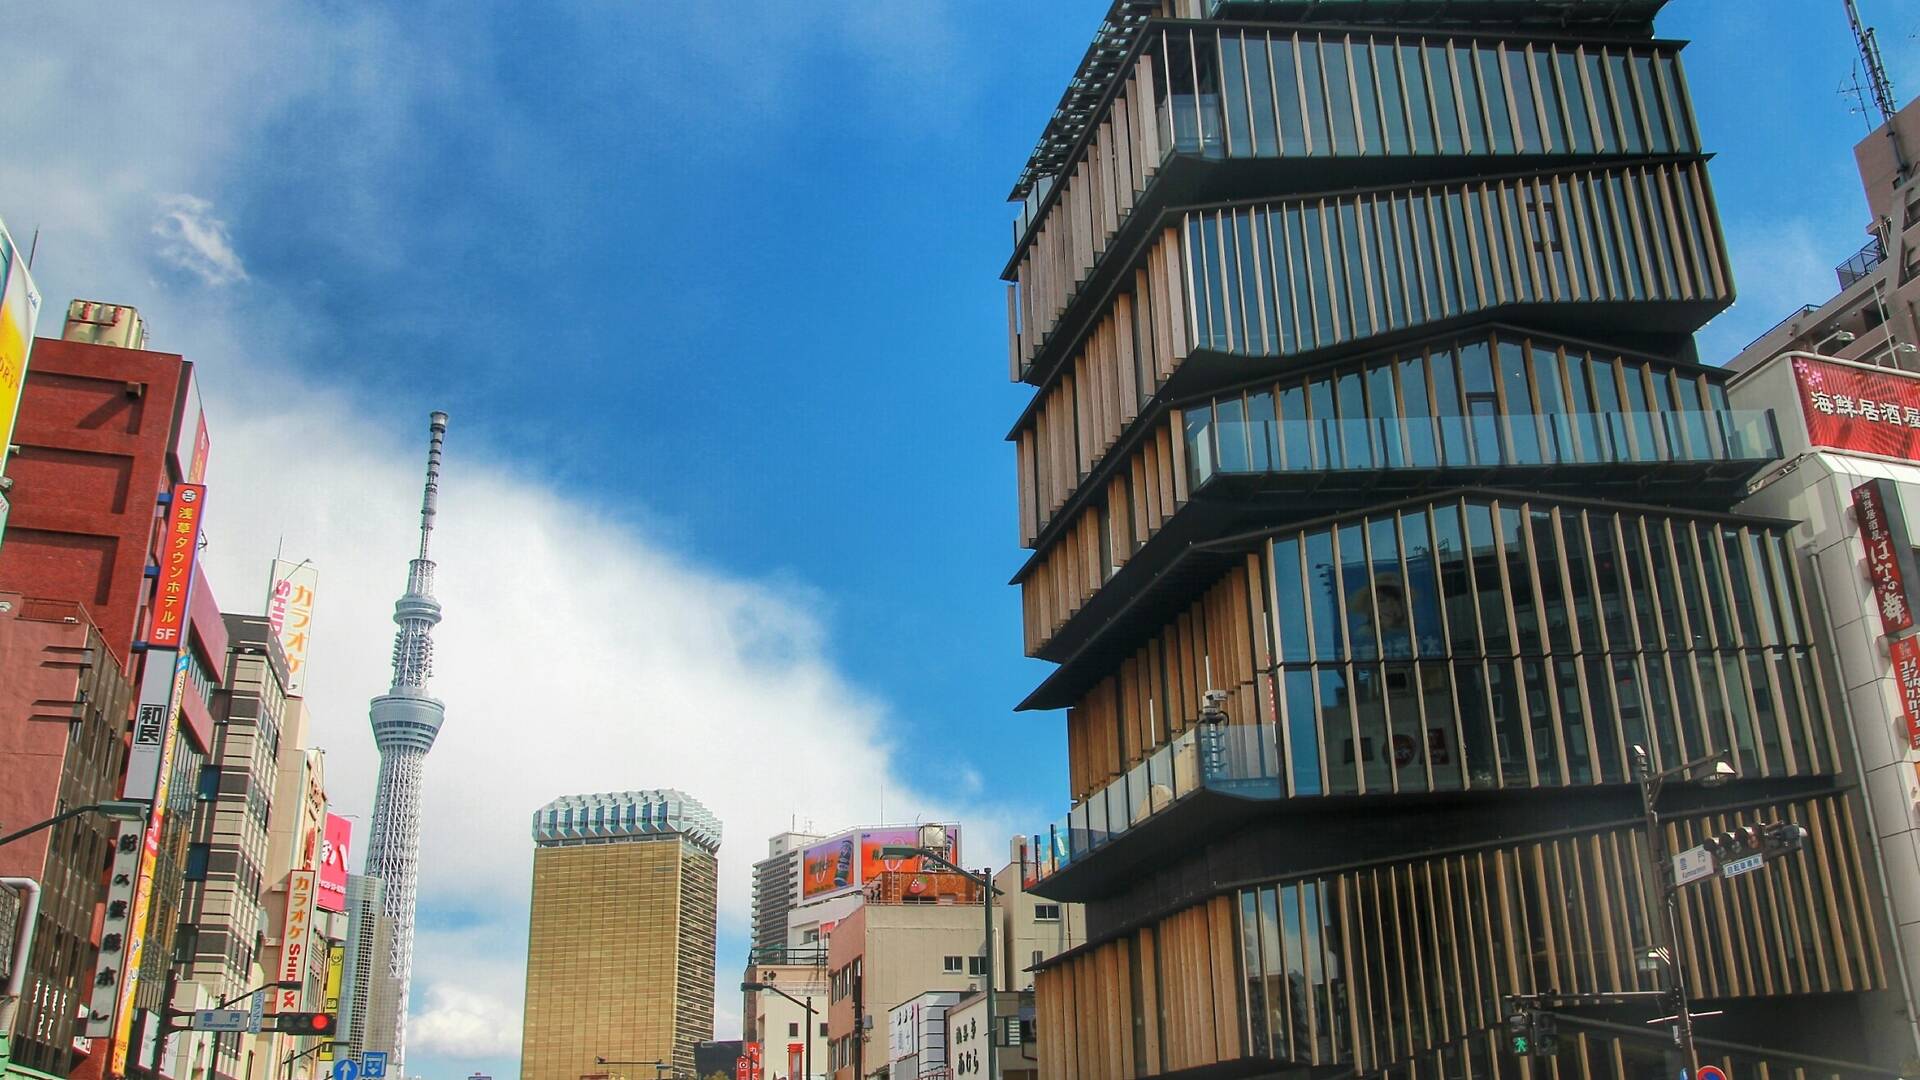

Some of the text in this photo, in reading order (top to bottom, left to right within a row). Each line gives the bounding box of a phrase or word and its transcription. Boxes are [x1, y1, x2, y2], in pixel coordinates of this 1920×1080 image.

[1811, 391, 1920, 428] 海鮮居酒屋
[160, 507, 193, 624] 浅草タウンホテル
[1870, 540, 1905, 625] はなの舞
[155, 627, 178, 641] 5F
[287, 584, 313, 674] カラオケ
[137, 705, 163, 743] 和民
[288, 876, 310, 940] カラオケ
